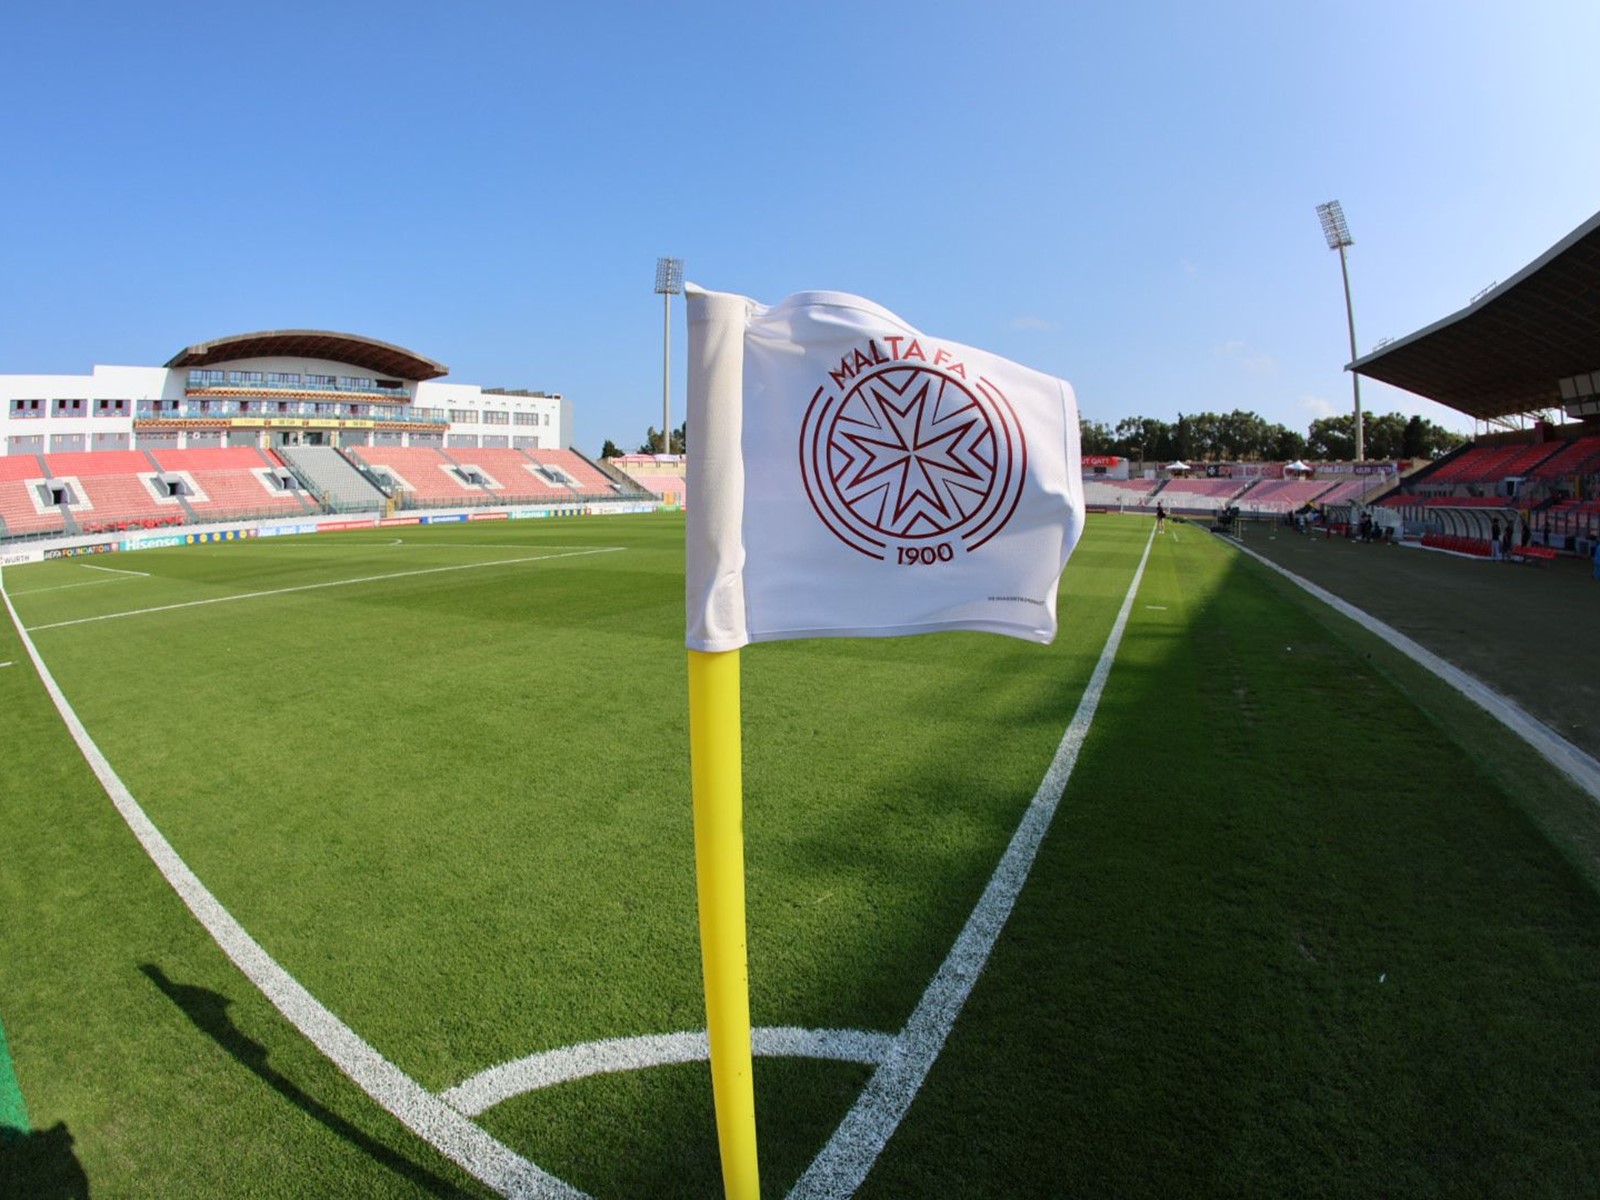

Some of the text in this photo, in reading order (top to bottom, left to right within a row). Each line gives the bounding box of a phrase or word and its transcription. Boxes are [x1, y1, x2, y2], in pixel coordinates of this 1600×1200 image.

[828, 336, 967, 390] MALTA FA
[62, 544, 110, 557] FOUNDATION
[126, 537, 180, 551] Hisense
[896, 542, 953, 565] 1900
